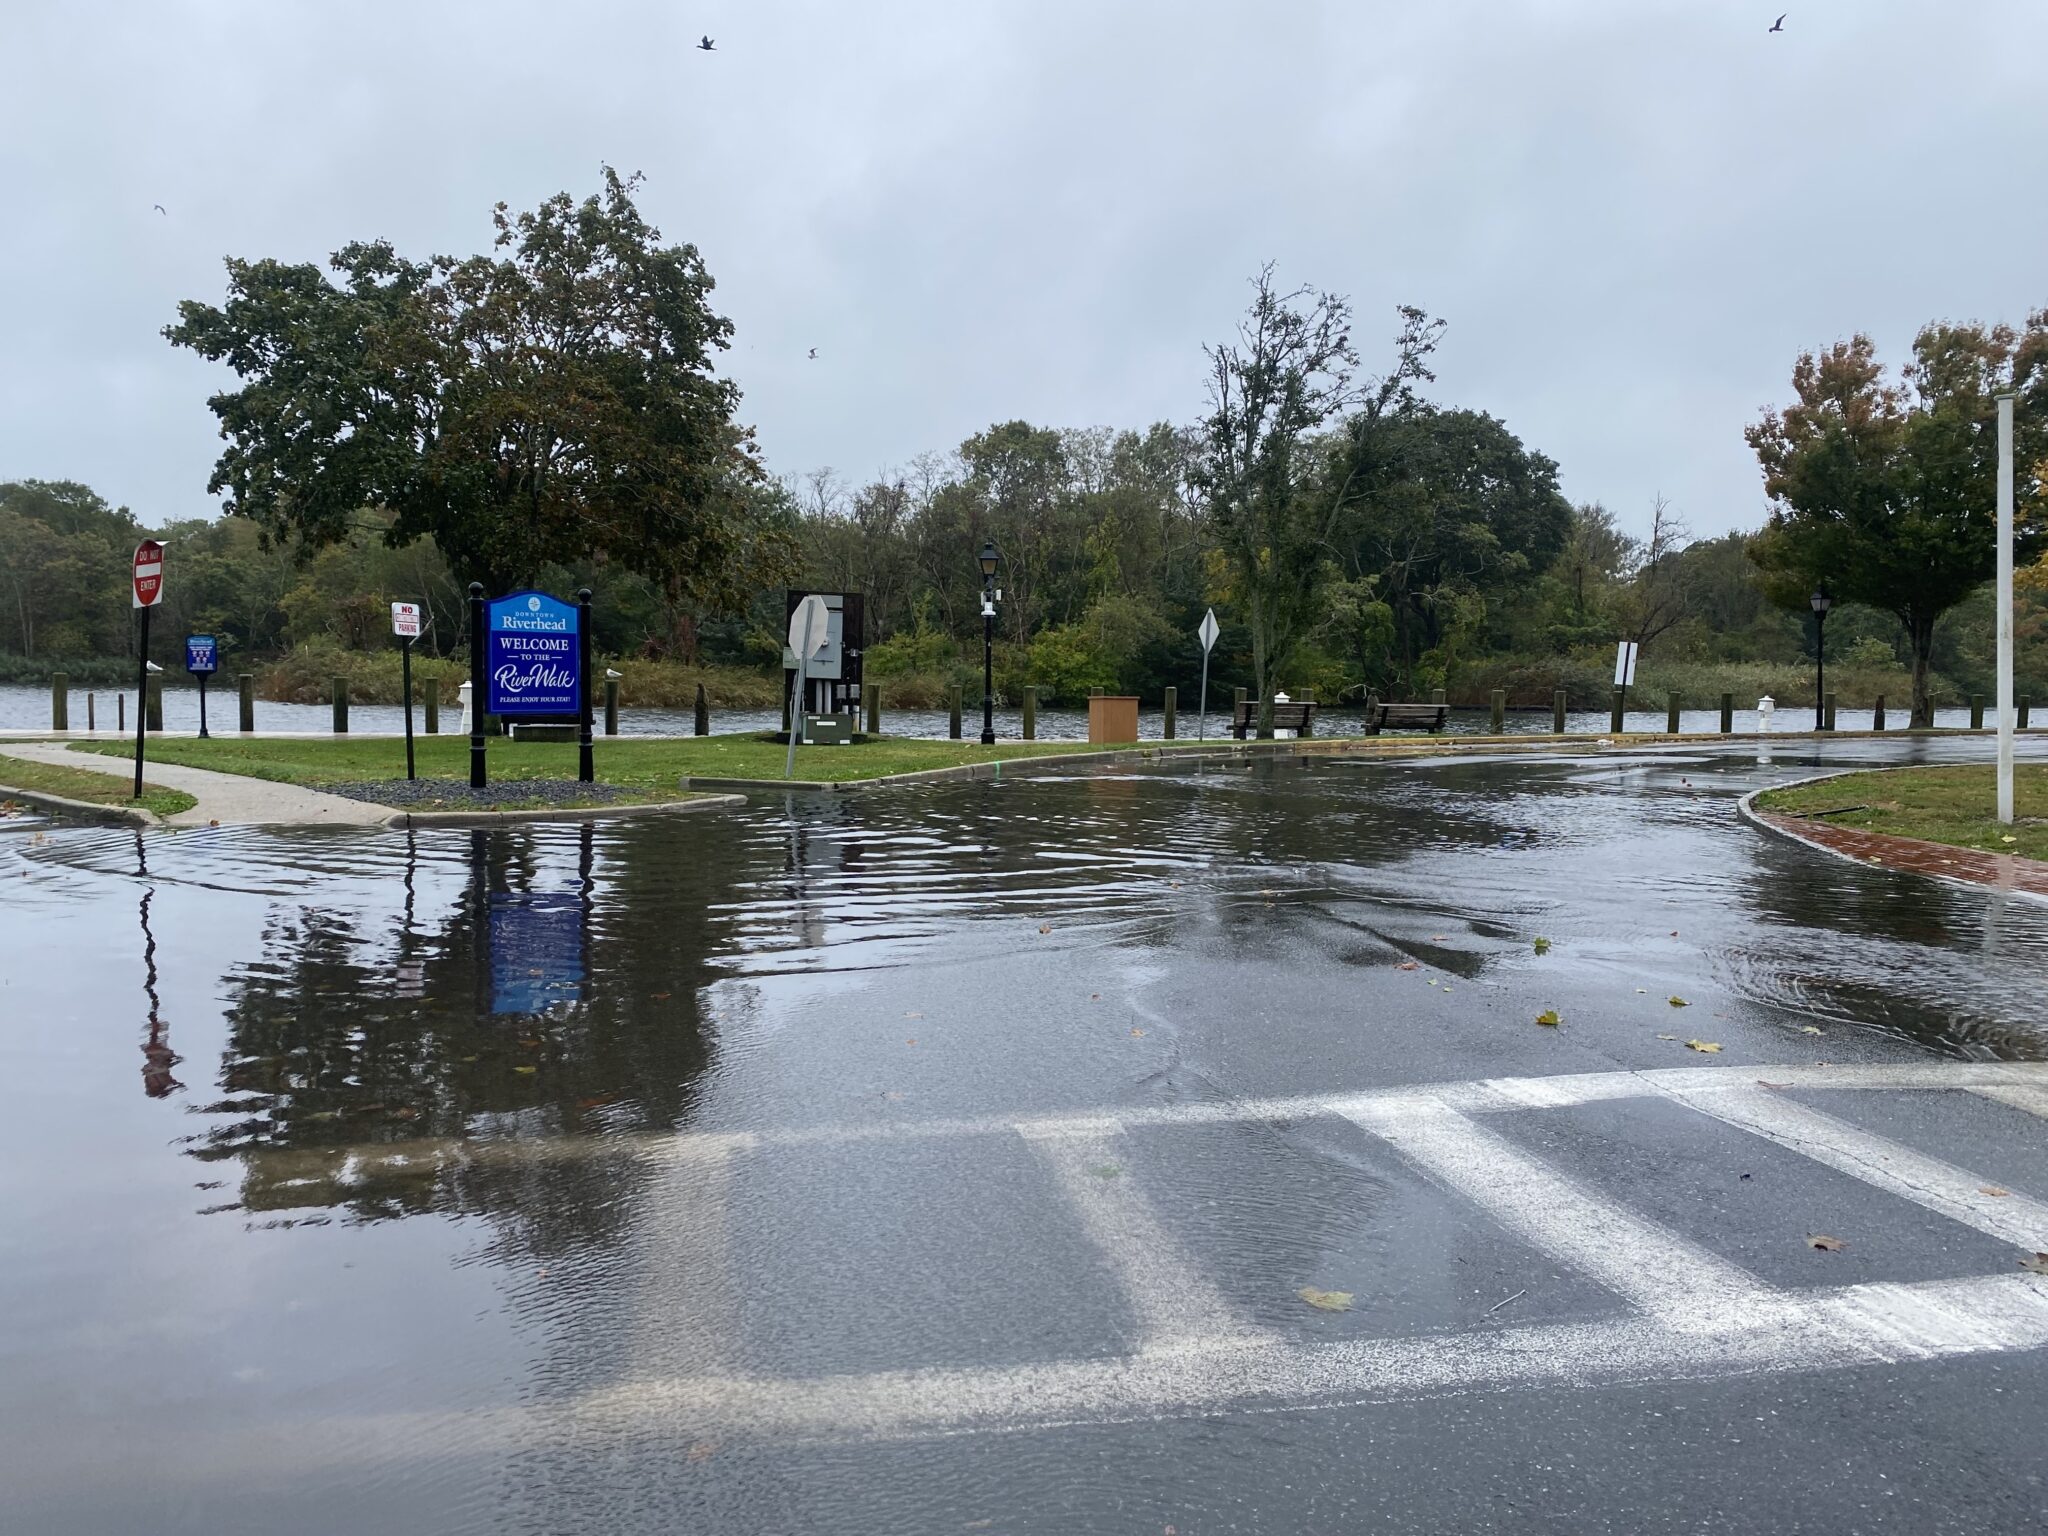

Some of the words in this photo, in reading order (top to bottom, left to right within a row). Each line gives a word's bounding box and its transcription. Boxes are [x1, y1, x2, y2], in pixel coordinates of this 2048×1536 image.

[140, 551, 147, 561] DO
[149, 549, 159, 560] NOT
[140, 579, 156, 591] ENTER
[502, 615, 566, 630] Riverhead
[500, 637, 569, 651] WELCOME
